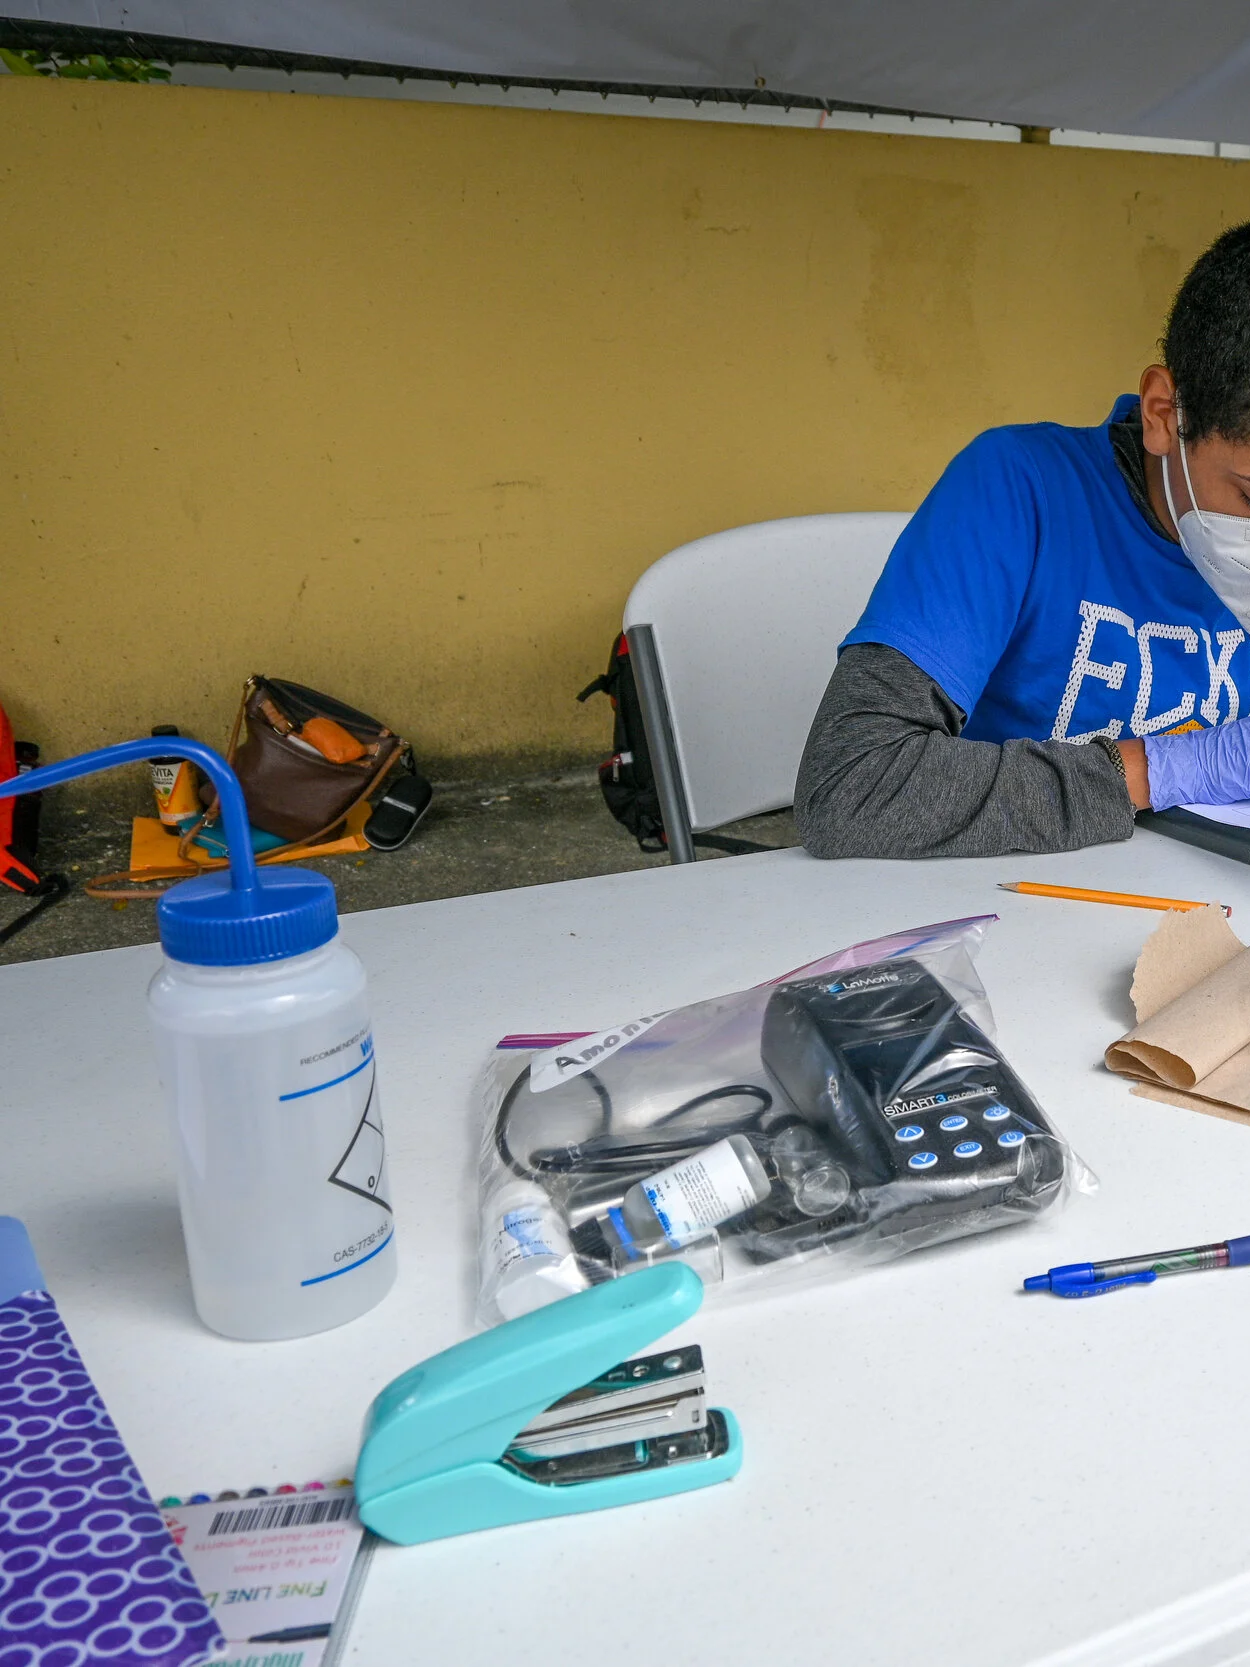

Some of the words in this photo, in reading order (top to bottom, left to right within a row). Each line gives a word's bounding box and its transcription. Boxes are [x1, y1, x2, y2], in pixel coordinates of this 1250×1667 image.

[300, 1034, 360, 1066] RECOMMENDED
[942, 1117, 965, 1128] ENTER
[959, 1143, 977, 1151] EXIT
[223, 1586, 273, 1605] LINE
[275, 1580, 327, 1598] FINE
